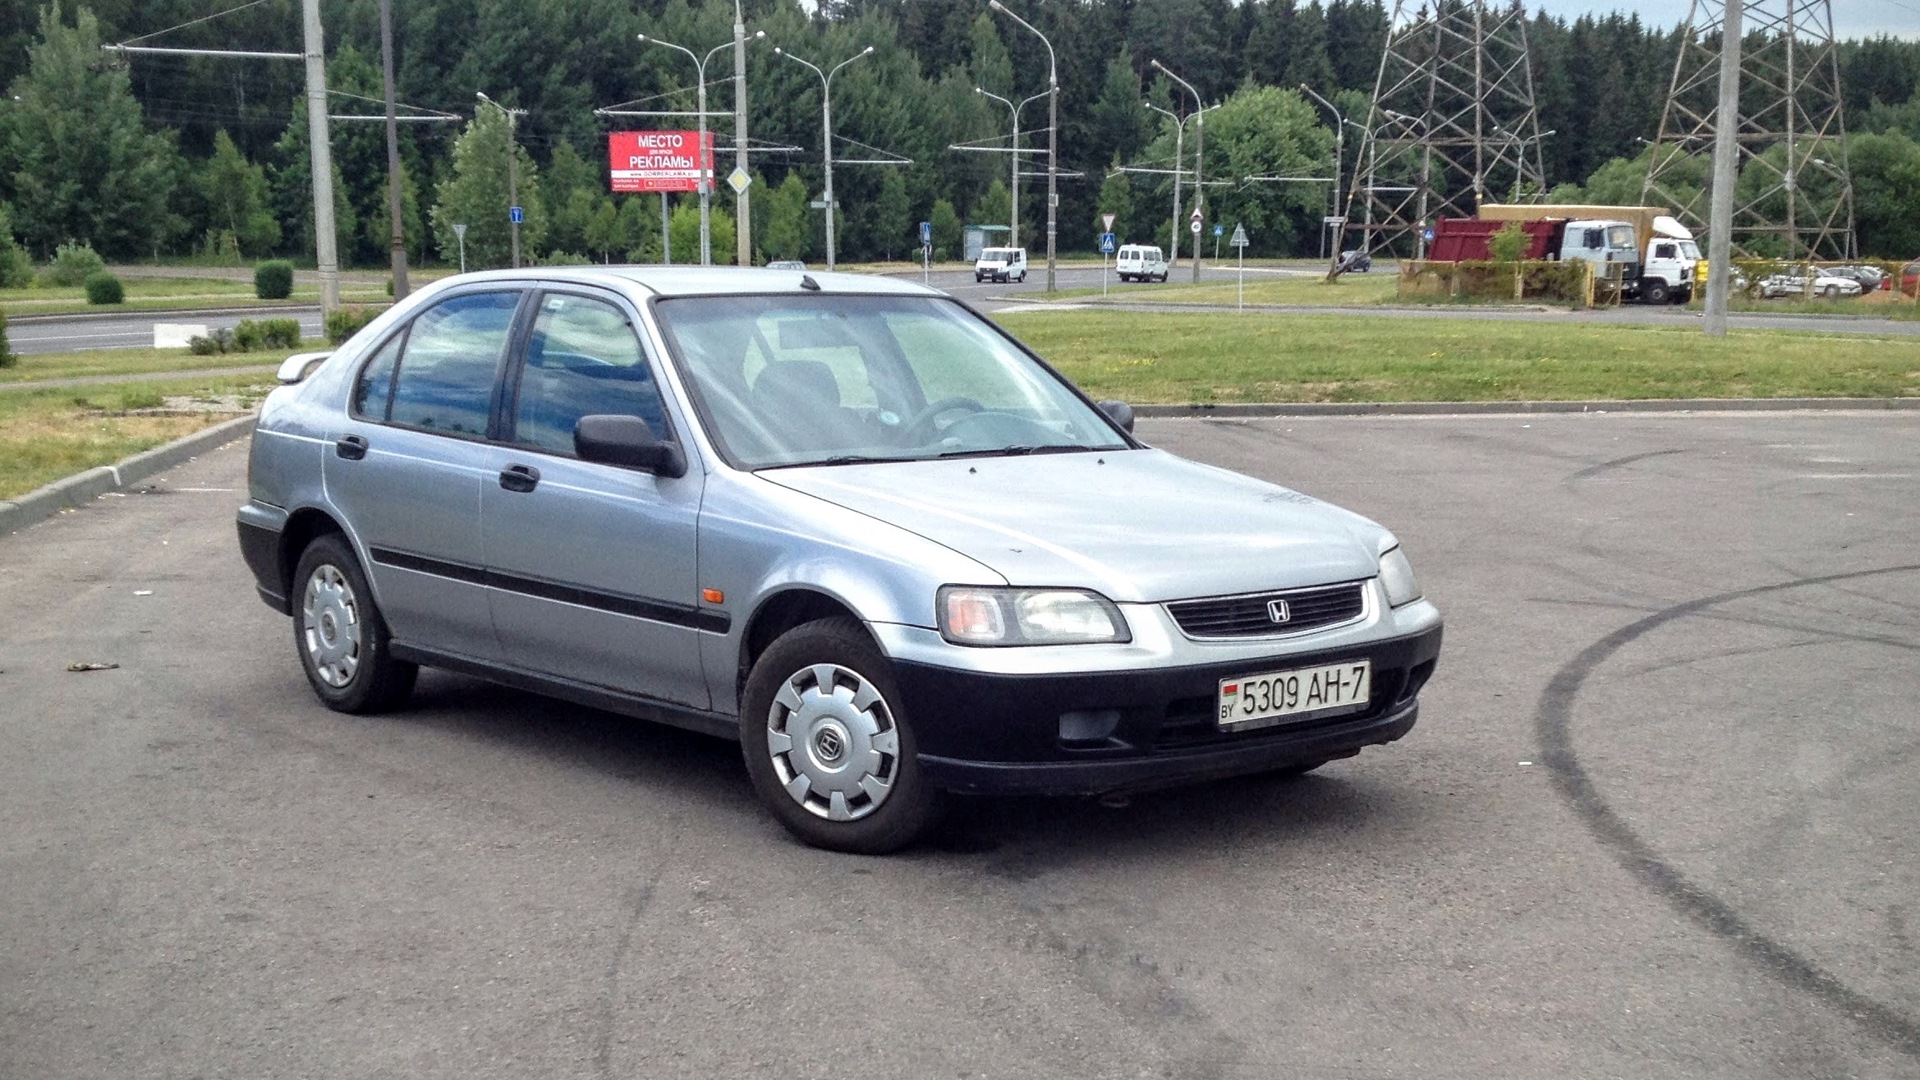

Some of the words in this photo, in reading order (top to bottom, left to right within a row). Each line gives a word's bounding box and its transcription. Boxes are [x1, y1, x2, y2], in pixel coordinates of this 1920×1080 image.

[638, 135, 683, 148] МЕСТО
[629, 155, 694, 168] РЕКЛАМЫ
[1243, 676, 1299, 714] 5309
[1306, 666, 1365, 707] AH-7
[1221, 704, 1234, 719] BY
